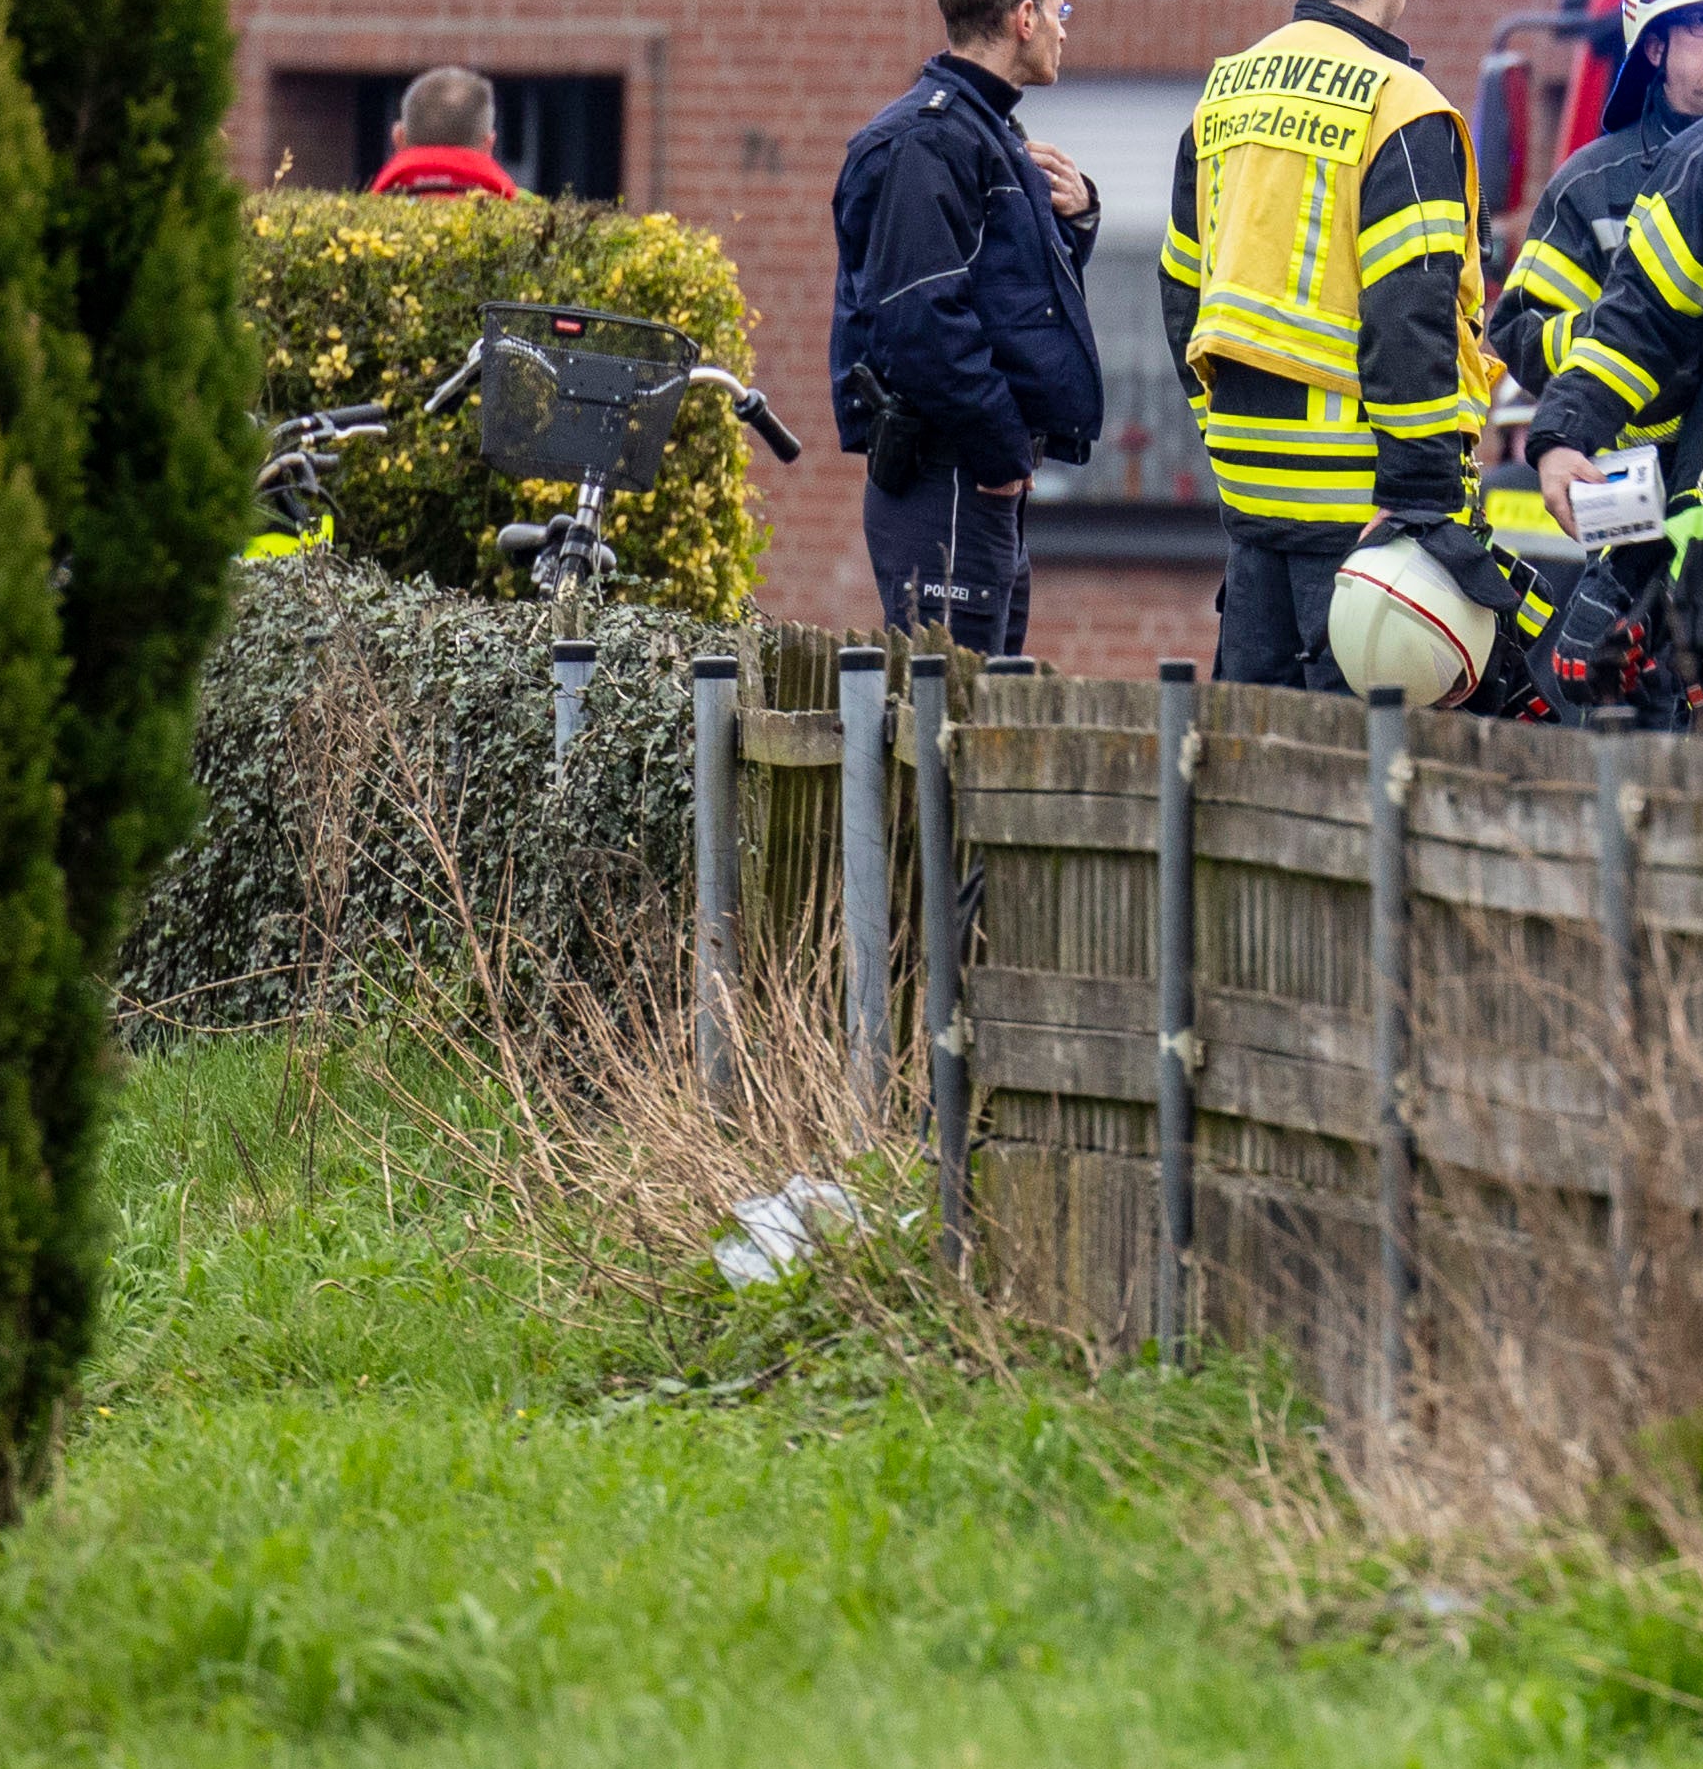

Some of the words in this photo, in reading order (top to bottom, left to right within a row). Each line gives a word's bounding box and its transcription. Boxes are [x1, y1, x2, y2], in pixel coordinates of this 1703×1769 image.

[1207, 55, 1378, 104] FEUERWEHR
[1202, 106, 1357, 152] Einsatzleiter
[923, 583, 970, 602] POLIZEI
